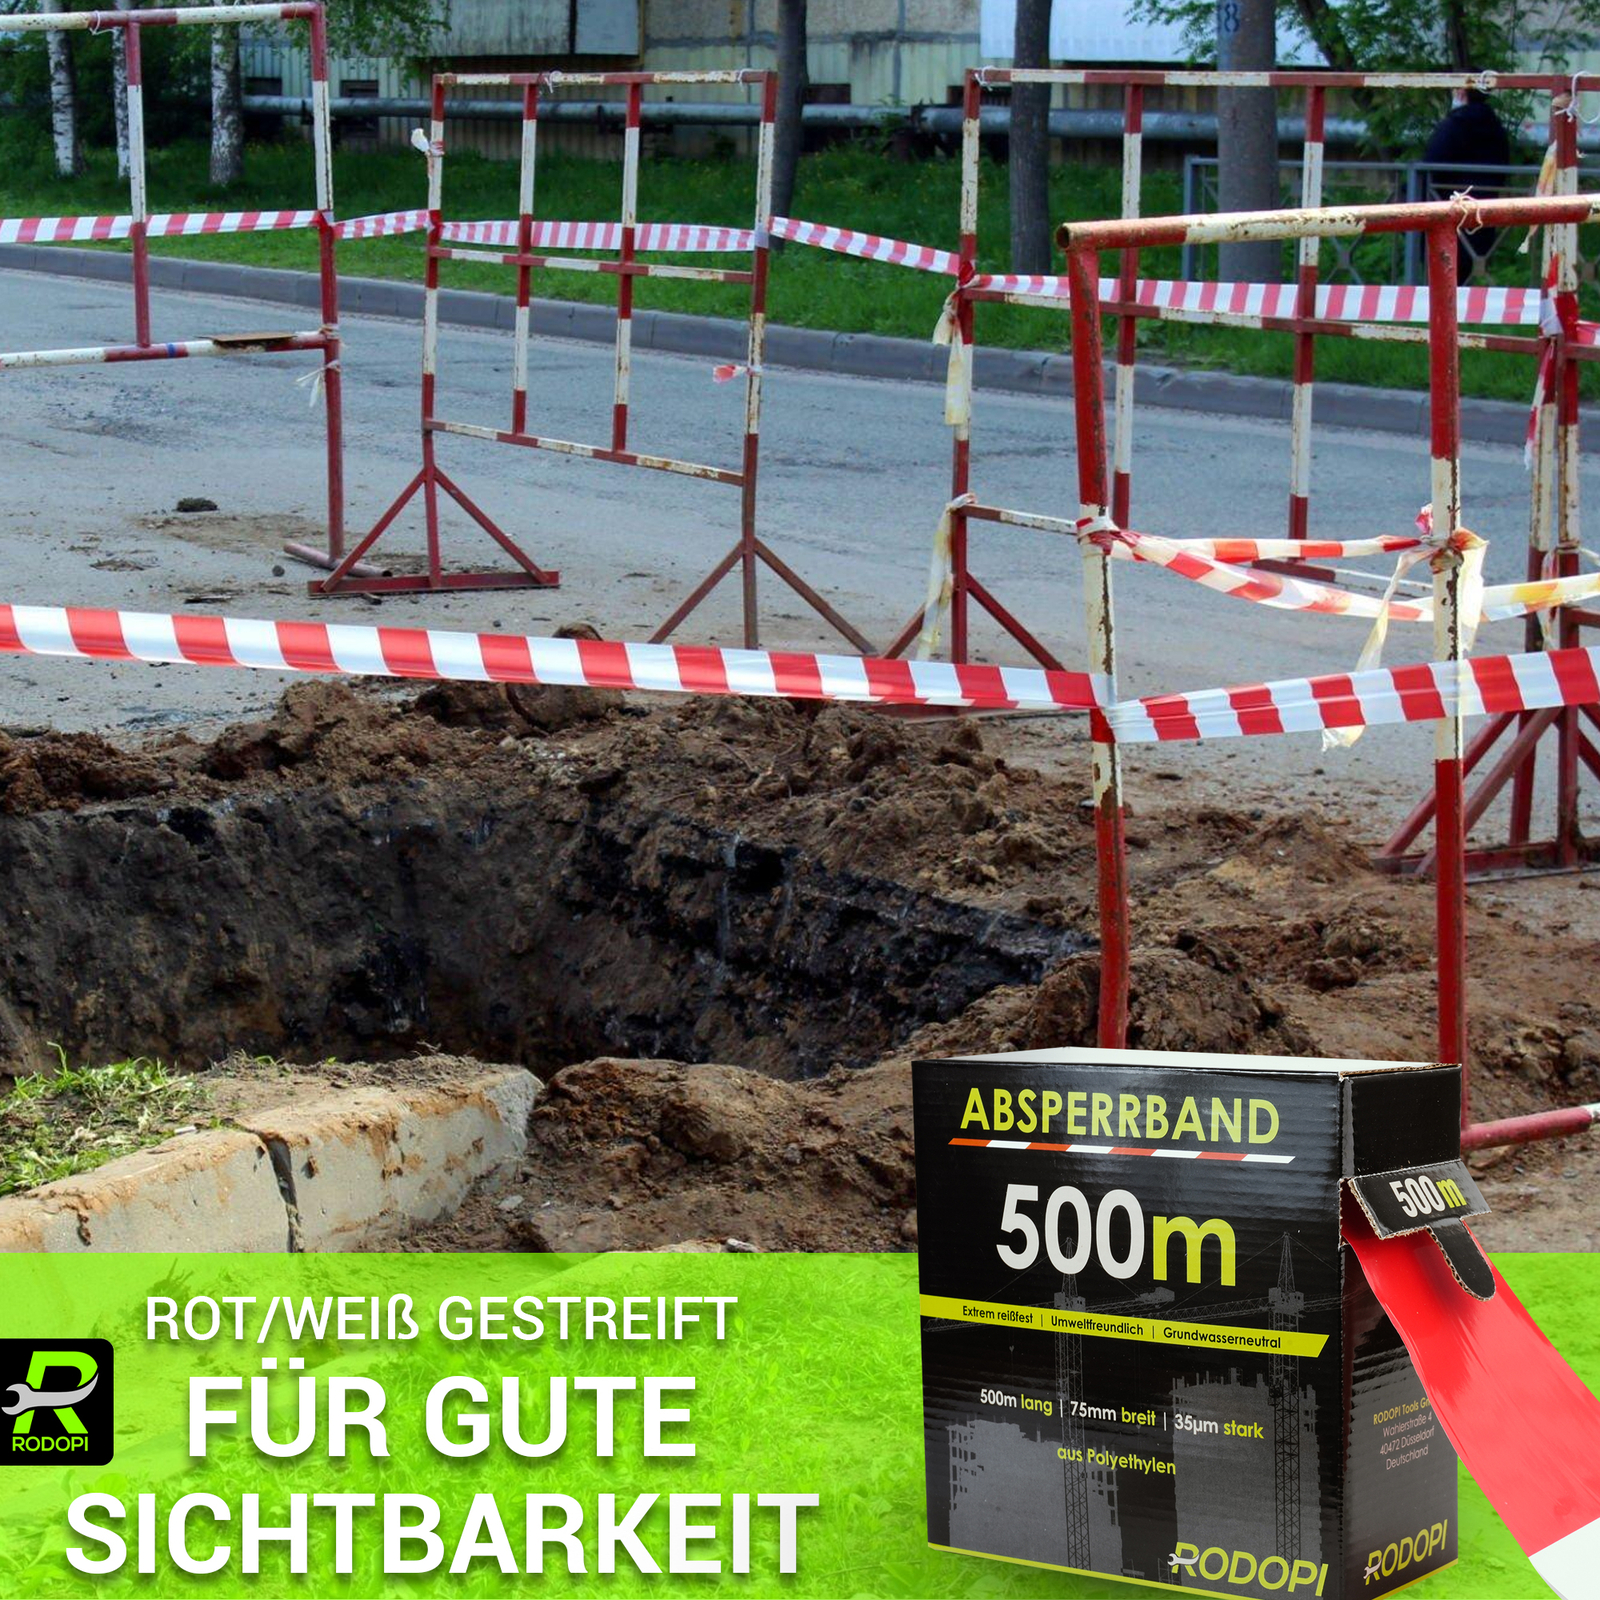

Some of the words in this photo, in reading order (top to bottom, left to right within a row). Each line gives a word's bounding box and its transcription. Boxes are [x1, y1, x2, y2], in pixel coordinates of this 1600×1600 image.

[961, 1087, 1280, 1144] ABSPERRBAND
[1390, 1175, 1468, 1219] 500m
[996, 1183, 1237, 1287] 500m
[962, 1305, 995, 1320] Extrem
[997, 1310, 1033, 1324] reißfest
[1051, 1315, 1144, 1335] Umweltfreundlich
[1163, 1327, 1281, 1349] Grundwasserneutral
[980, 1388, 1017, 1408] 500m
[1020, 1393, 1053, 1417] lang
[1070, 1400, 1117, 1421] 75mm
[1121, 1406, 1157, 1427] breit
[1223, 1419, 1265, 1440] stark
[1373, 1406, 1401, 1425] RODOPI
[1402, 1400, 1419, 1415] Tools
[1383, 1413, 1427, 1437] Wahlerstraße
[1428, 1411, 1433, 1421] 4
[1057, 1447, 1084, 1463] aus
[1087, 1448, 1177, 1475] Polyethylen
[1380, 1438, 1400, 1455] 40472
[1401, 1425, 1435, 1448] Düsseldorf
[1386, 1444, 1429, 1470] Deutschland
[1168, 1541, 1329, 1597] RODOPI
[1363, 1519, 1448, 1586] RODOPI
